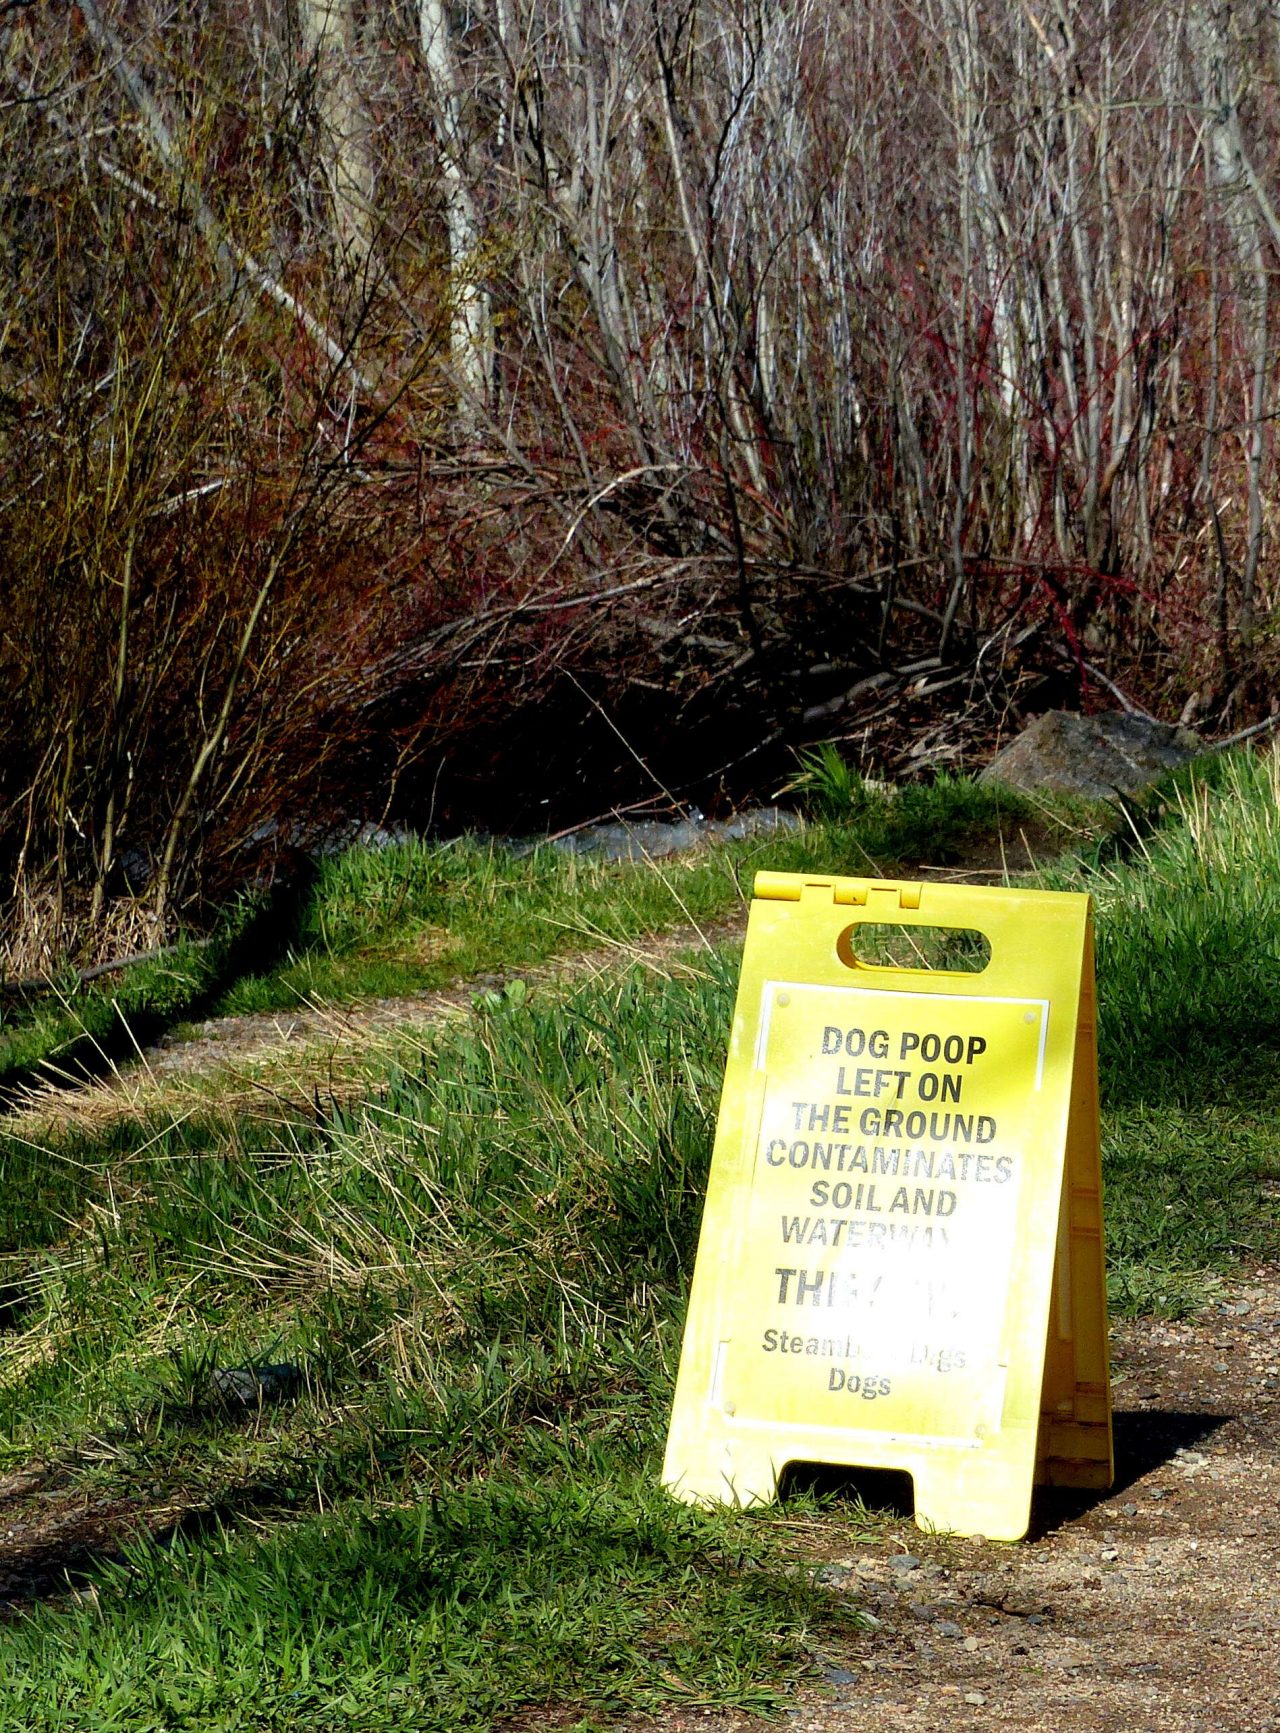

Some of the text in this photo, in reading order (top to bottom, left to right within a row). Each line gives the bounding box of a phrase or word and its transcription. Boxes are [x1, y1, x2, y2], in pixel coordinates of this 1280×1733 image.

[821, 1026, 987, 1065] DOG POOP
[836, 1066, 963, 1103] LEFT ON
[792, 1102, 997, 1144] THE GROUND
[765, 1138, 1013, 1184] CONTAMINATES
[809, 1180, 958, 1217] SOIL AND
[828, 1367, 892, 1400] Dogs
